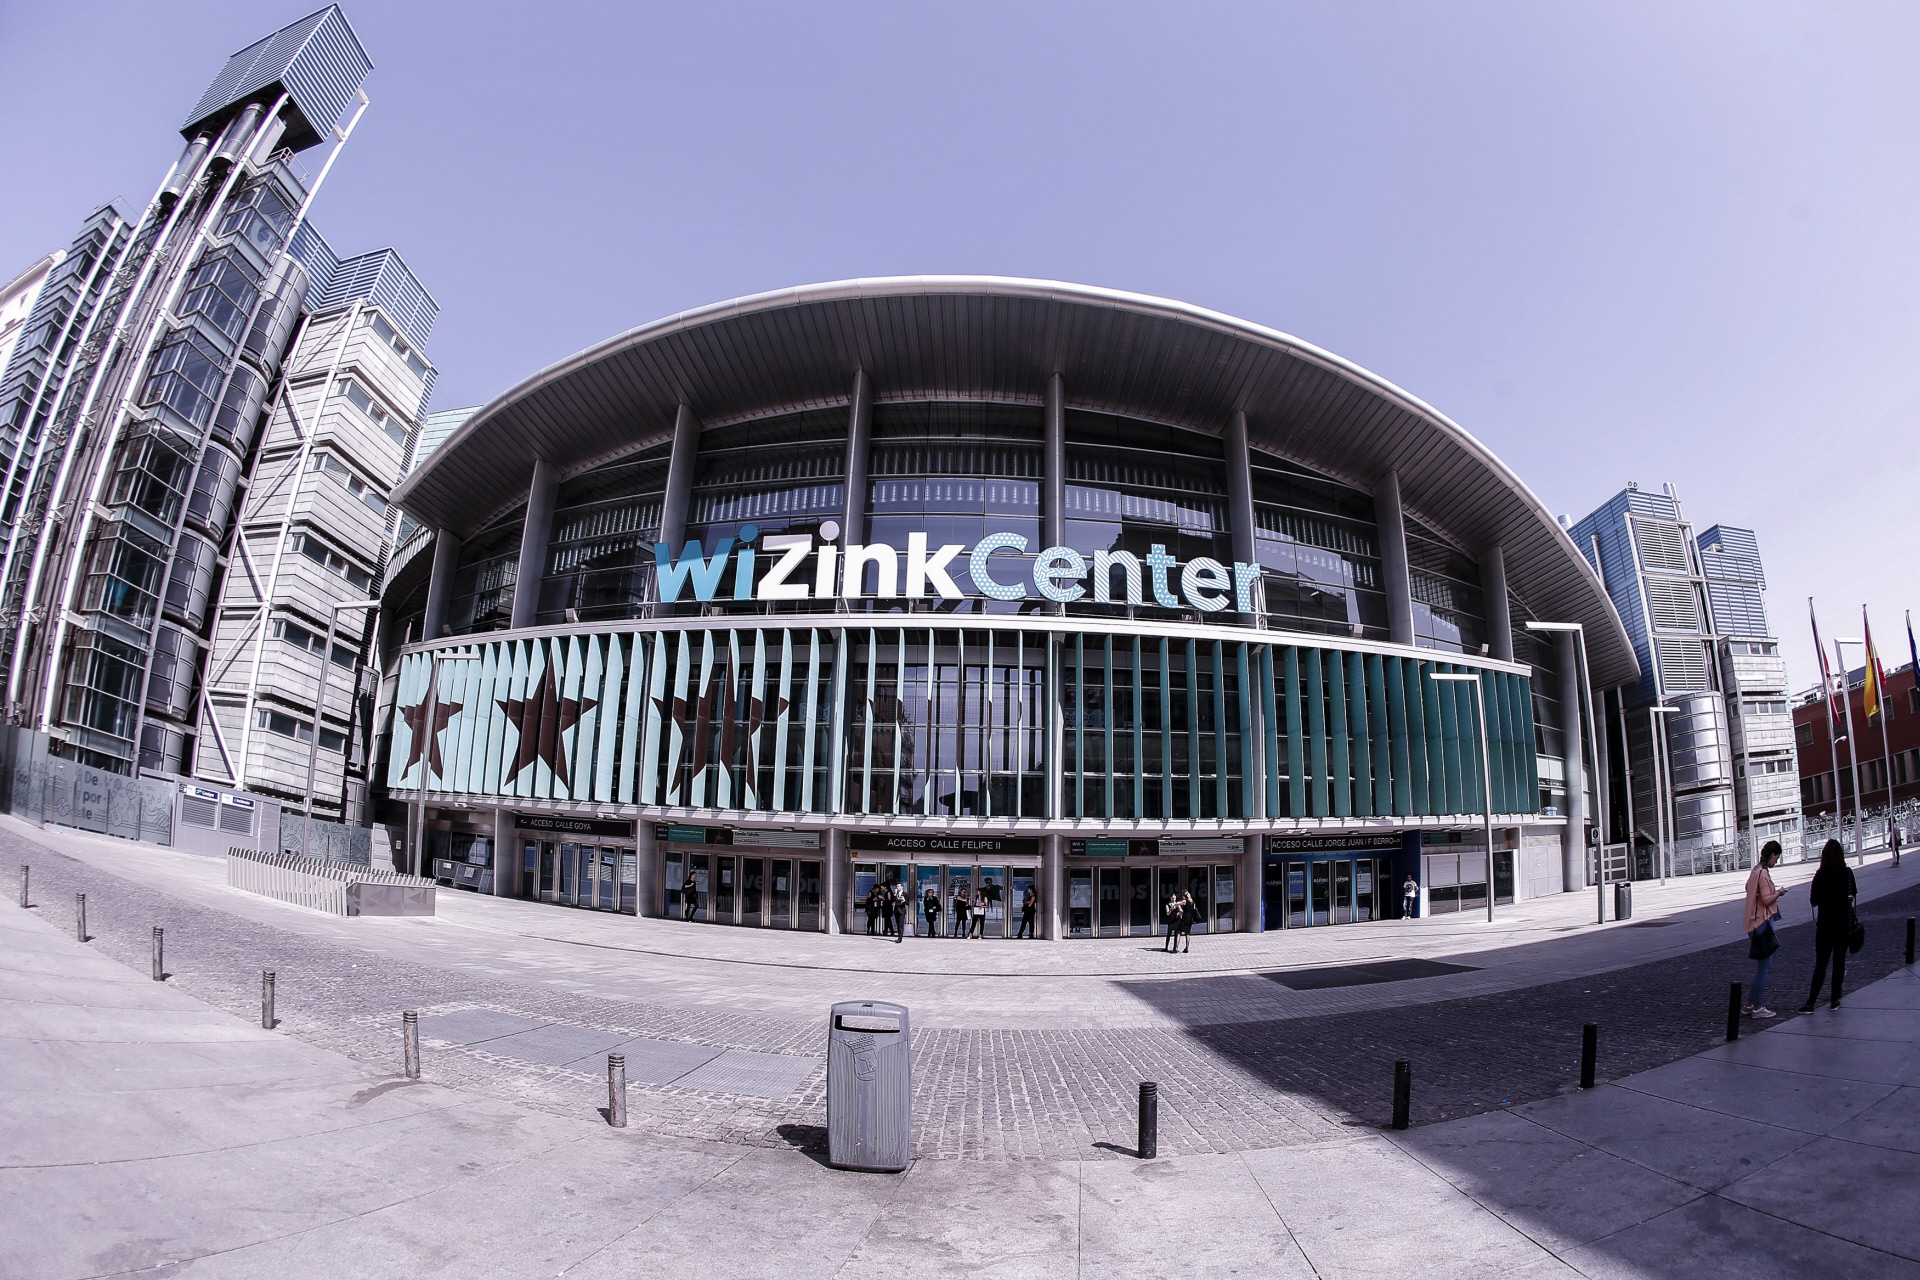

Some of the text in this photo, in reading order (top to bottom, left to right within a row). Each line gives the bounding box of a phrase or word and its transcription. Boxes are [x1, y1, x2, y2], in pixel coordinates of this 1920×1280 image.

[82, 791, 102, 804] por
[530, 819, 591, 831] ACCESO CALLE GOYA
[887, 838, 1001, 850] ACCESO CALLE FELIPE II
[1272, 840, 1300, 849] ACCESO
[1301, 839, 1323, 848] CALLE
[1324, 838, 1346, 847] JORGE
[1347, 838, 1364, 846] JUAN
